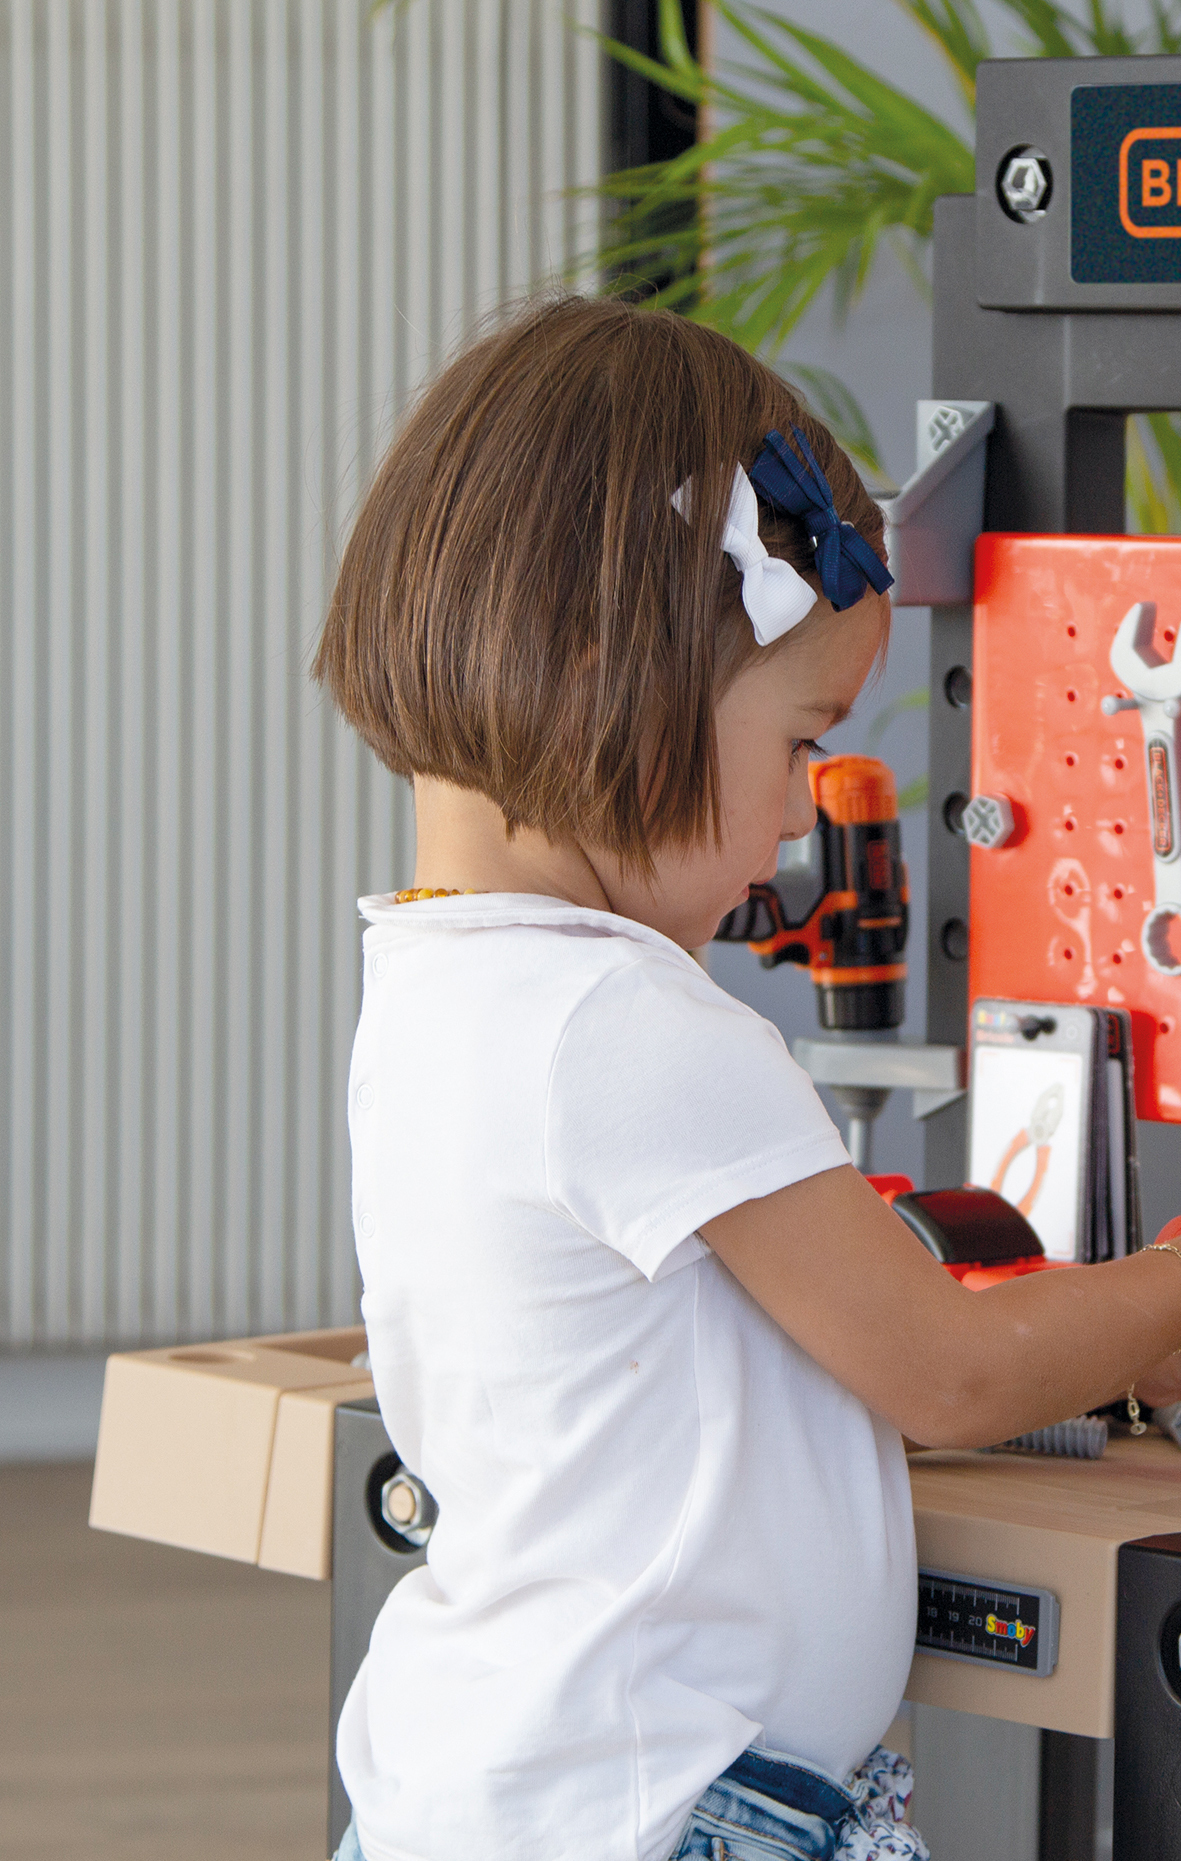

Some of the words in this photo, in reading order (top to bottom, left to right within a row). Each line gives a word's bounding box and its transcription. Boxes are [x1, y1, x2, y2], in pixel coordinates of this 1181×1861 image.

[927, 1606, 938, 1618] 18
[948, 1610, 960, 1622] 19
[968, 1614, 983, 1627] 20
[985, 1613, 1036, 1648] Smoby
